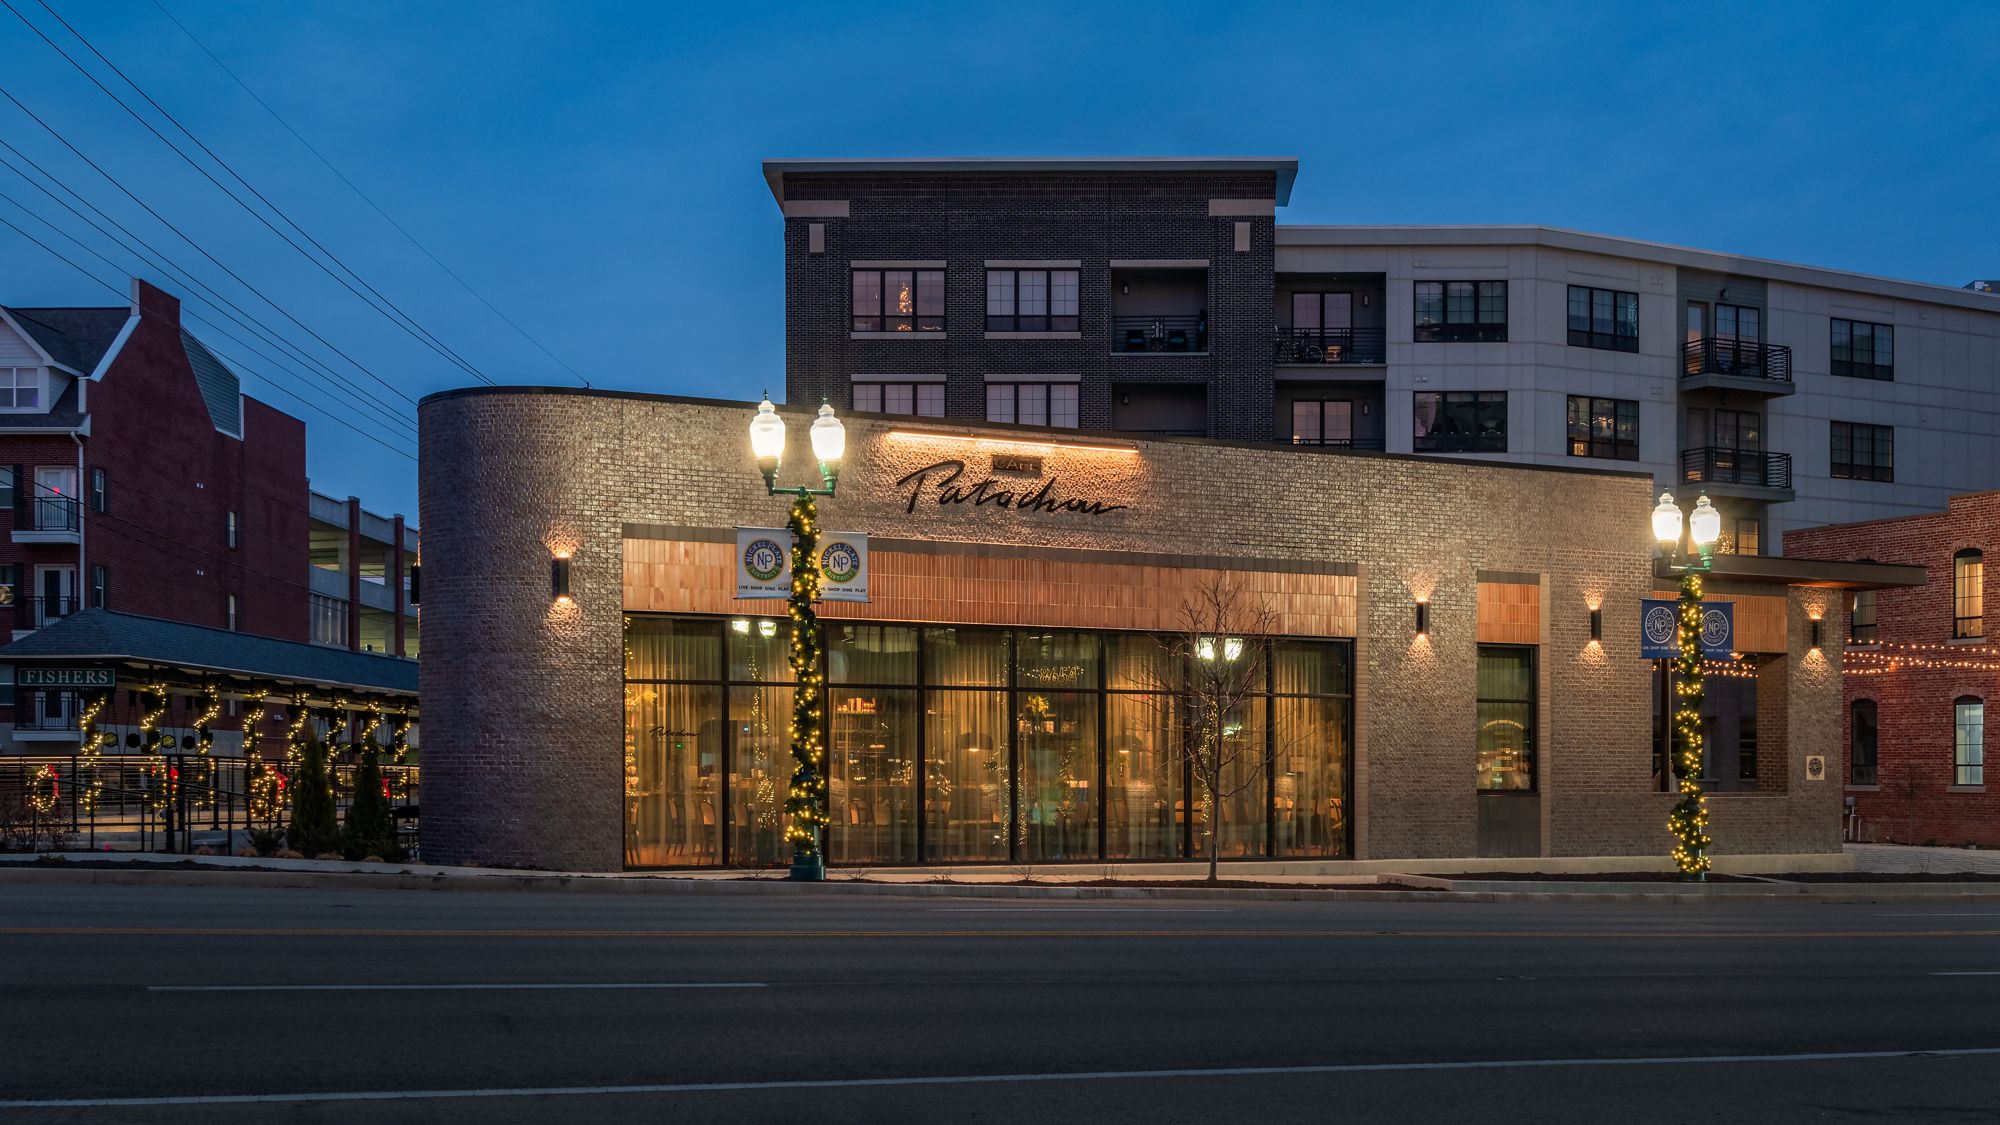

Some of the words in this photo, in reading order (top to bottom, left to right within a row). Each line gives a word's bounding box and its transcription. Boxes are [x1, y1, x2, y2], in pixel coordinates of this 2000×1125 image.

[896, 459, 1127, 514] Patachou
[746, 542, 766, 563] NICKEL
[767, 541, 783, 565] PLATE
[757, 552, 773, 569] NP
[822, 544, 842, 566] NICKEL
[843, 544, 859, 567] PLATE
[833, 554, 849, 571] NP
[752, 567, 777, 580] DISTRICT
[826, 570, 854, 582] DISTRICT
[1654, 618, 1666, 632] NP
[1708, 622, 1720, 636] NP
[26, 670, 108, 684] FISHERS
